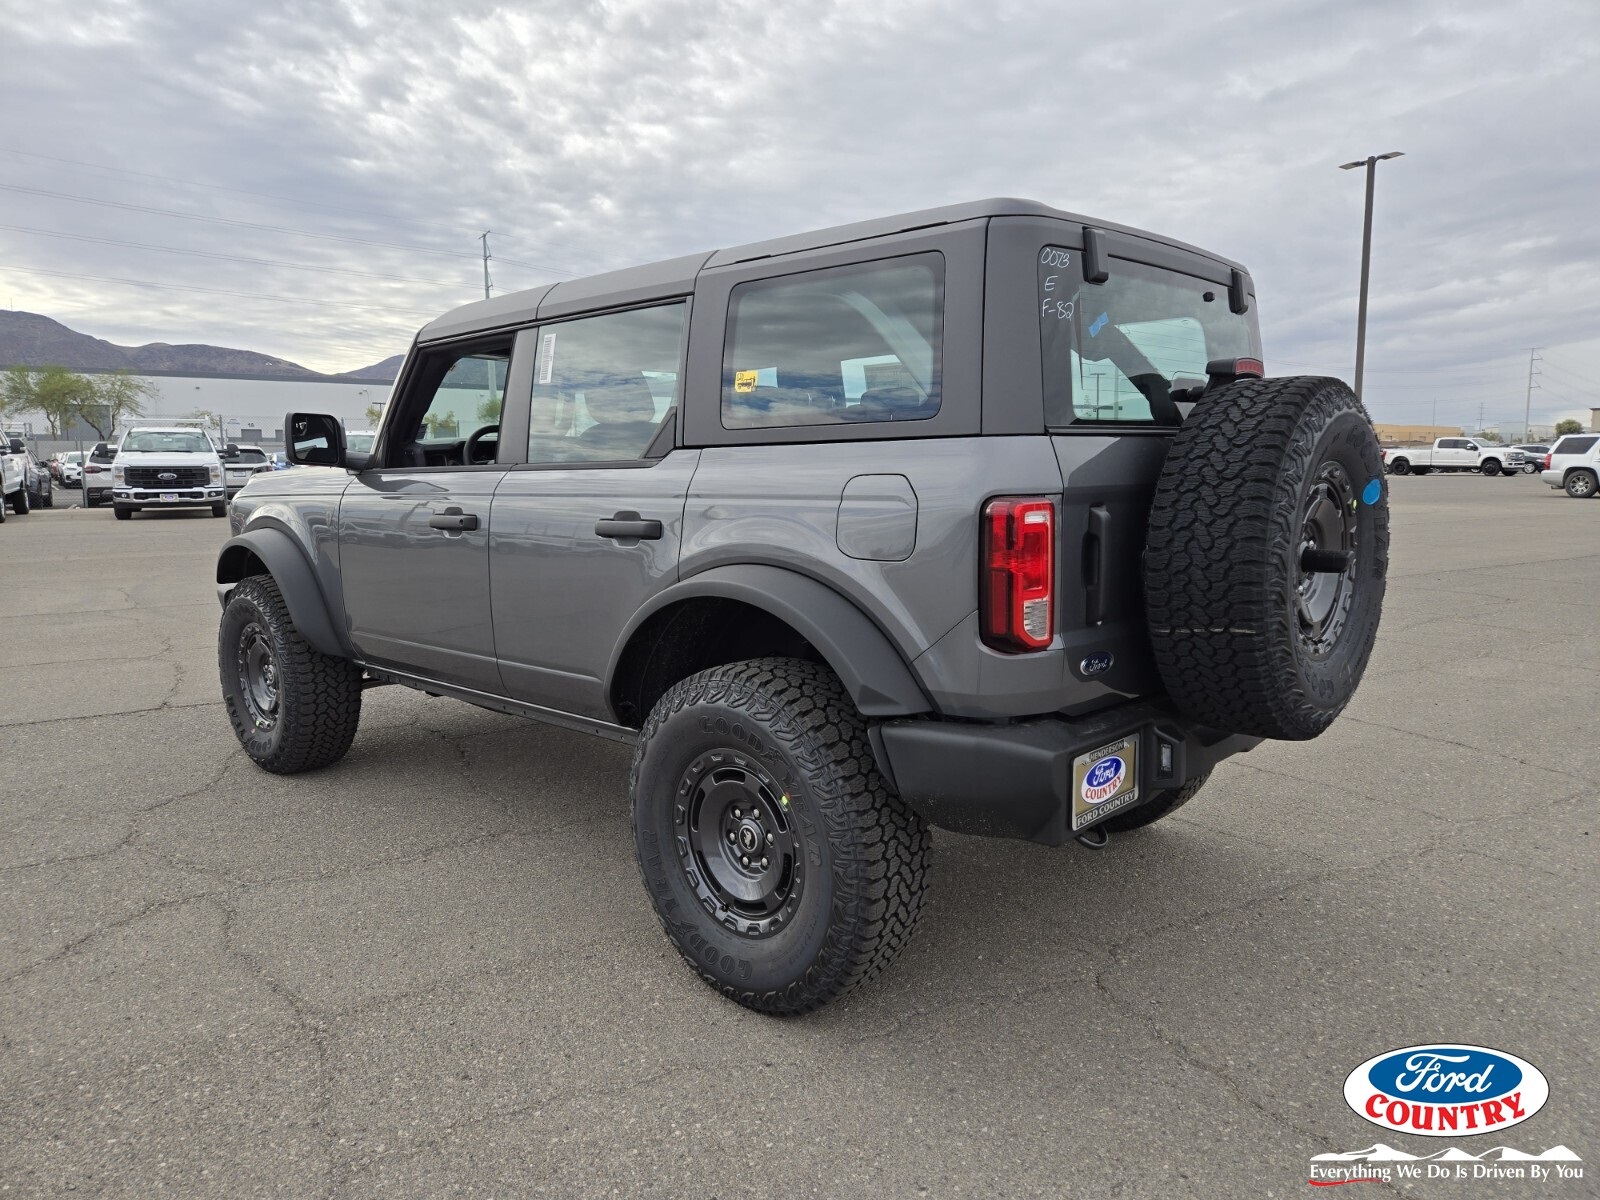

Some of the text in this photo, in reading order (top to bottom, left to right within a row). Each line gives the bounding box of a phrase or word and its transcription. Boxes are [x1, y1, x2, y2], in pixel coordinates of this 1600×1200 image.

[1044, 275, 1059, 291] E
[1042, 297, 1075, 320] F-82
[1089, 739, 1125, 762] HENDERSON
[1092, 759, 1116, 786] Ford
[1085, 772, 1122, 800] COUNTRY
[1077, 791, 1135, 827] FORD COUNTRY
